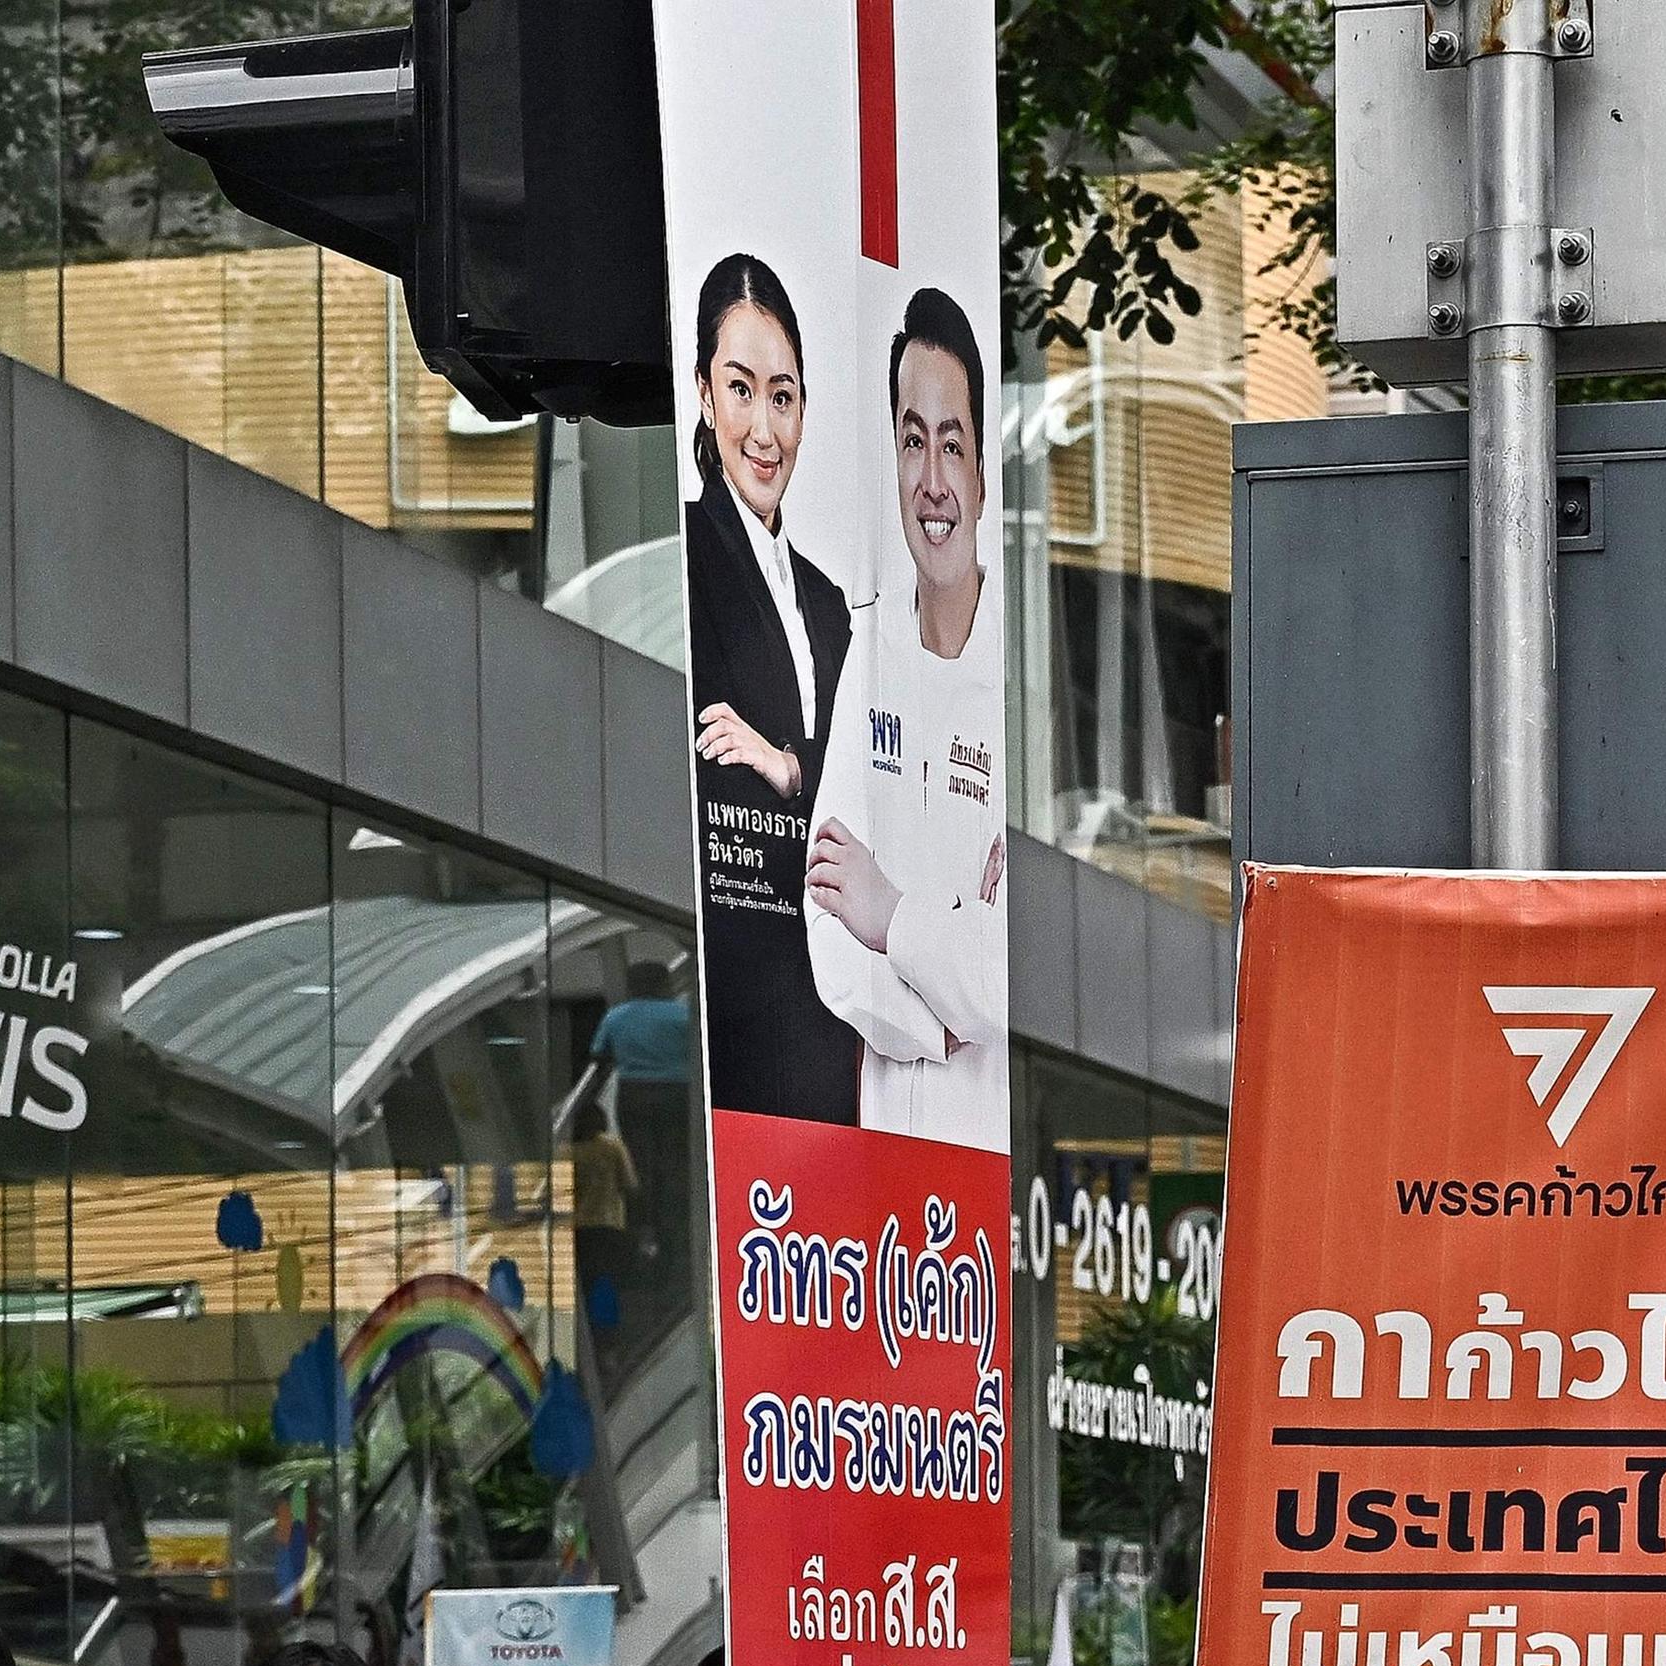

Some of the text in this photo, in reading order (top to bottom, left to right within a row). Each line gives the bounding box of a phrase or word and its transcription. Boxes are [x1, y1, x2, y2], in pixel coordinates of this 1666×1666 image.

[706, 800, 807, 841] แพทองธาร
[708, 836, 765, 870] ชินวัตร
[1029, 1176, 1223, 1321] 0-2619-20
[743, 1368, 1006, 1503] ภมรมนตรี
